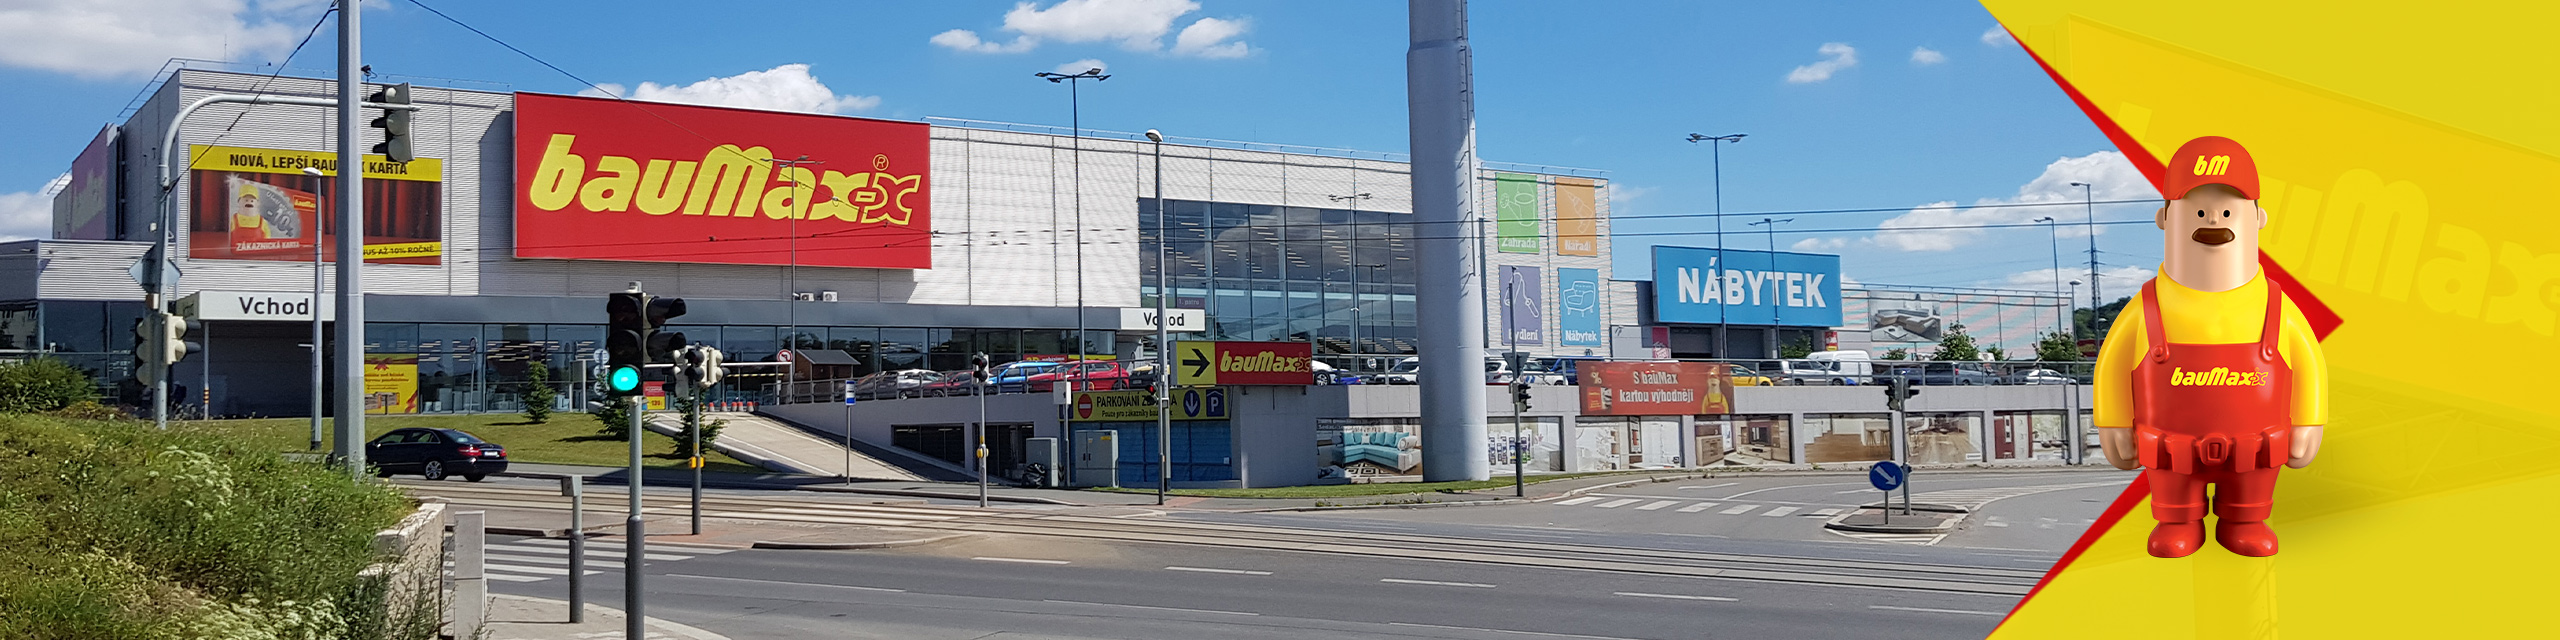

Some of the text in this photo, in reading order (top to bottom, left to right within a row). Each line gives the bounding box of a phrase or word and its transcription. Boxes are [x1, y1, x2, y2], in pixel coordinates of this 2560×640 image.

[229, 153, 268, 169] NOVÁ,
[272, 155, 309, 169] LEPŠÍ
[369, 161, 408, 175] KARTA
[235, 241, 281, 252] ZÁKAZNICKÁ
[1501, 237, 1537, 249] Zahrada
[1564, 239, 1592, 251] Nářadí
[1677, 256, 1827, 308] NÁBYTEK
[238, 296, 309, 316] Vchod
[1143, 311, 1185, 327] Vcod
[1565, 329, 1598, 342] Nábytek
[1632, 371, 1679, 384] S bauMax
[1096, 391, 1140, 408] PARKOVÁNÍ
[1619, 388, 1650, 402] kartou
[1651, 388, 1694, 403] výhodněji
